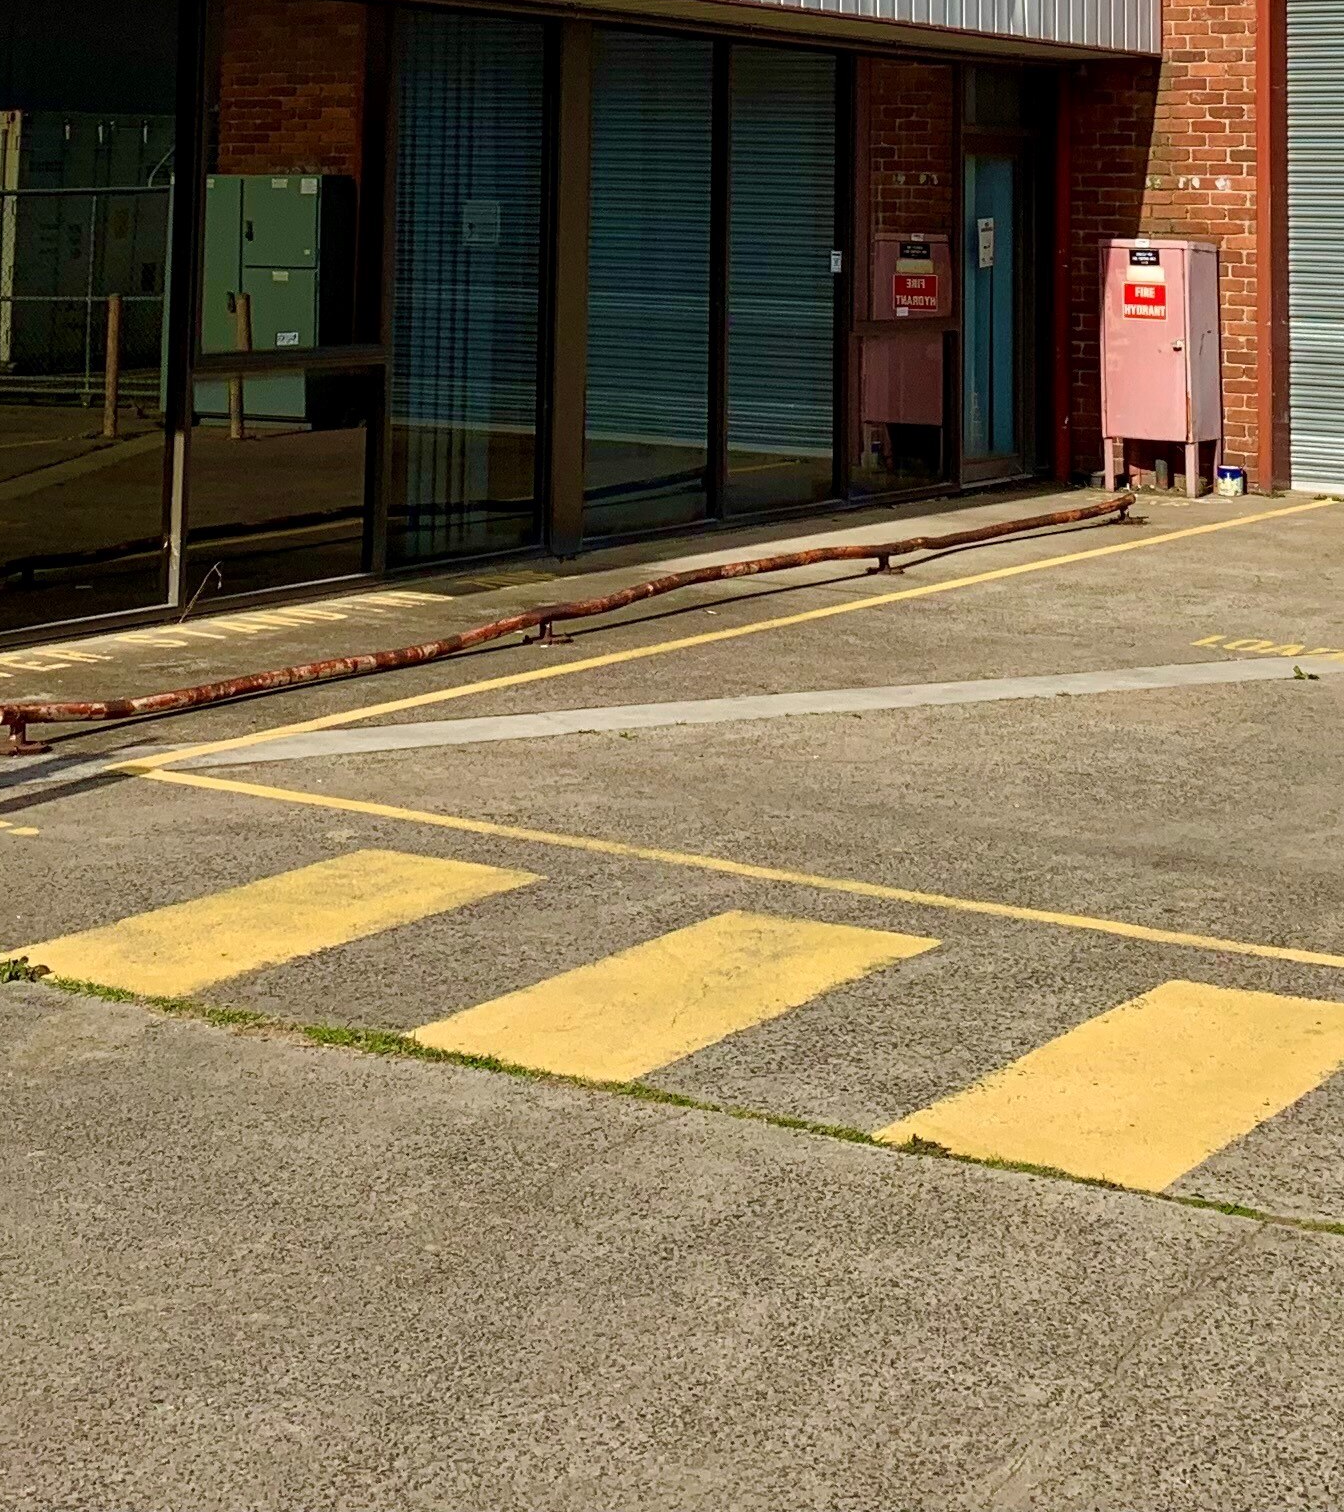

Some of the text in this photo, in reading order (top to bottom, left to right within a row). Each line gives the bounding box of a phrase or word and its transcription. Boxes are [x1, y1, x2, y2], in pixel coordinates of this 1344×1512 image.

[1134, 286, 1156, 299] FIRE
[1124, 303, 1166, 317] HYDRANT
[113, 590, 454, 648] STANDING
